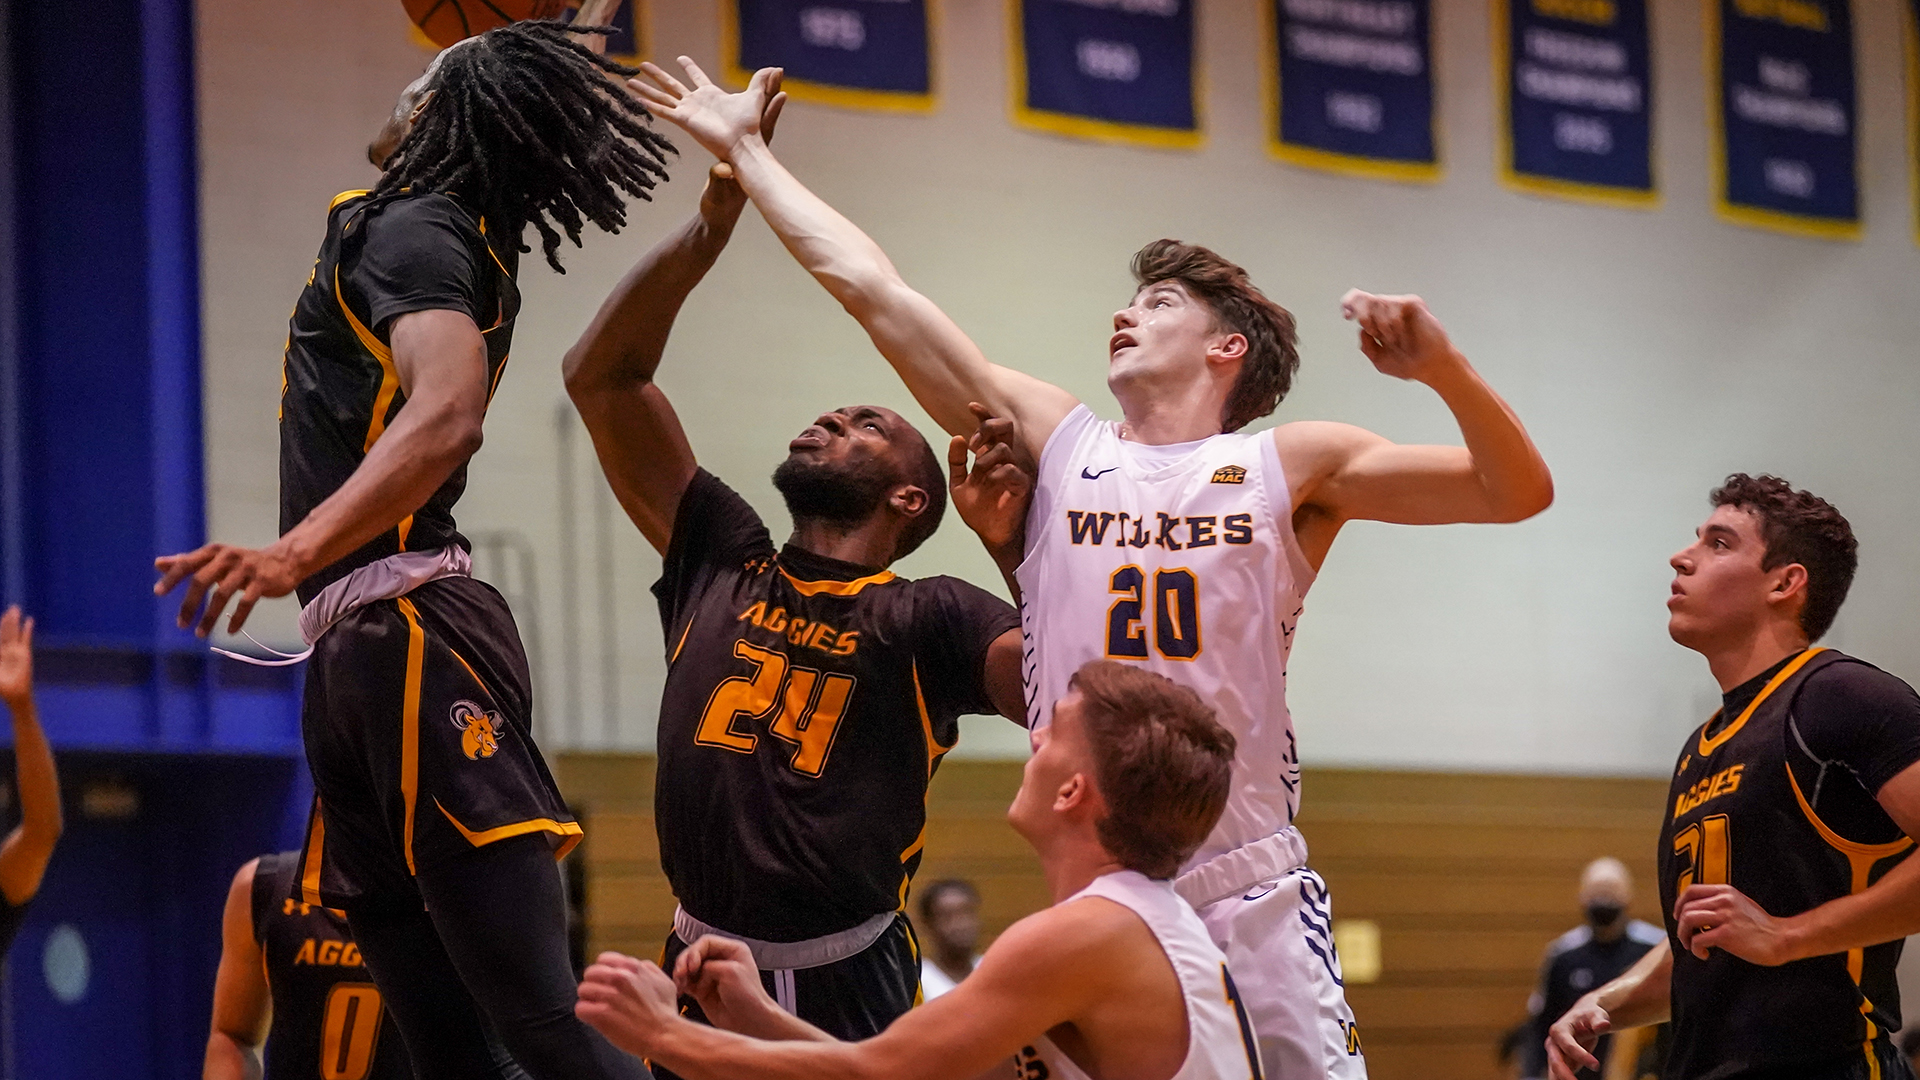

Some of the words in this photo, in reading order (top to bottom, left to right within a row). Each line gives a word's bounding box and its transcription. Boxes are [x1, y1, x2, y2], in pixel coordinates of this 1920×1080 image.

[1212, 474, 1244, 484] MAC
[1067, 511, 1253, 551] WILKES
[738, 601, 860, 656] AGGIES
[1105, 563, 1202, 661] 20
[695, 638, 857, 778] 24
[1674, 763, 1746, 822] AGGIES
[295, 938, 366, 967] AGG
